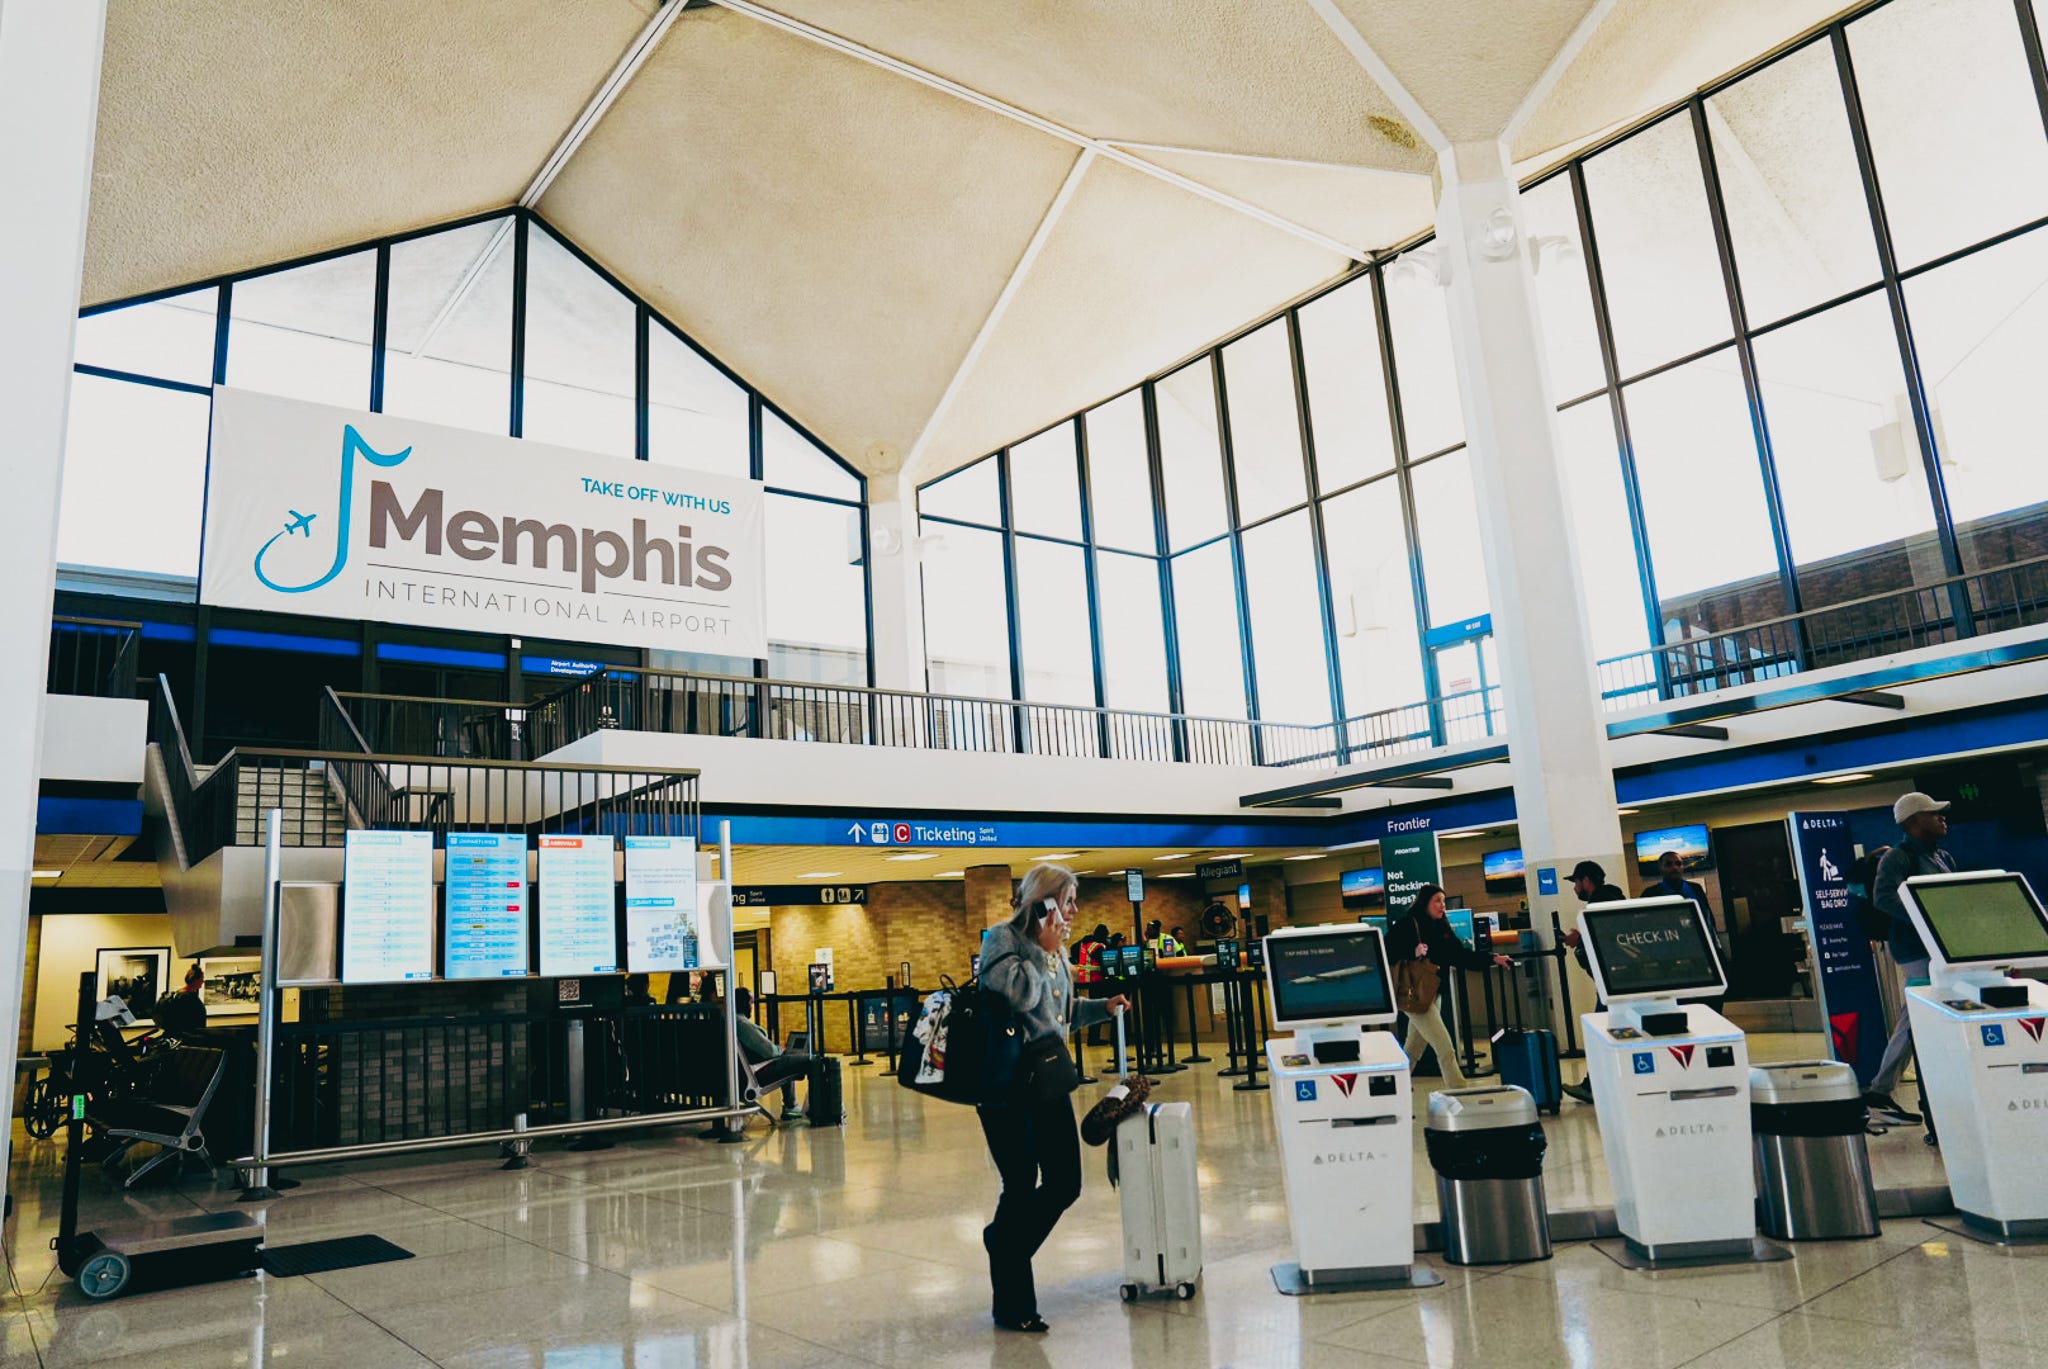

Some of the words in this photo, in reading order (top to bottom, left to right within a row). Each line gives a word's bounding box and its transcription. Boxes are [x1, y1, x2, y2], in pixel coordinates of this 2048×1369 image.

[581, 478, 624, 499] TAKE
[627, 486, 659, 504] OFF
[662, 491, 706, 510] WITH
[708, 498, 731, 515] US
[369, 480, 732, 594] Memphis
[365, 579, 608, 623] INTERNATIONAL
[623, 609, 731, 635] AIRPORT
[550, 667, 587, 675] Development
[551, 660, 571, 668] Airport
[572, 662, 598, 671] Authority
[1387, 817, 1431, 832] Frontier
[1810, 819, 1838, 829] DELTA
[896, 826, 908, 841] C
[915, 827, 976, 844] Ticketing
[979, 827, 994, 835] Spirit
[1394, 847, 1420, 856] FRONTIER
[1200, 864, 1238, 878] Allegiant
[1387, 870, 1404, 881] Not
[1389, 894, 1417, 905] Bags?
[1815, 888, 1849, 900] SELF-SERVI
[1820, 899, 1834, 909] BAG
[1616, 931, 1662, 945] CHECK
[1664, 929, 1680, 941] IN
[1669, 1124, 1715, 1136] DELTA
[1327, 1152, 1375, 1163] DELTA
